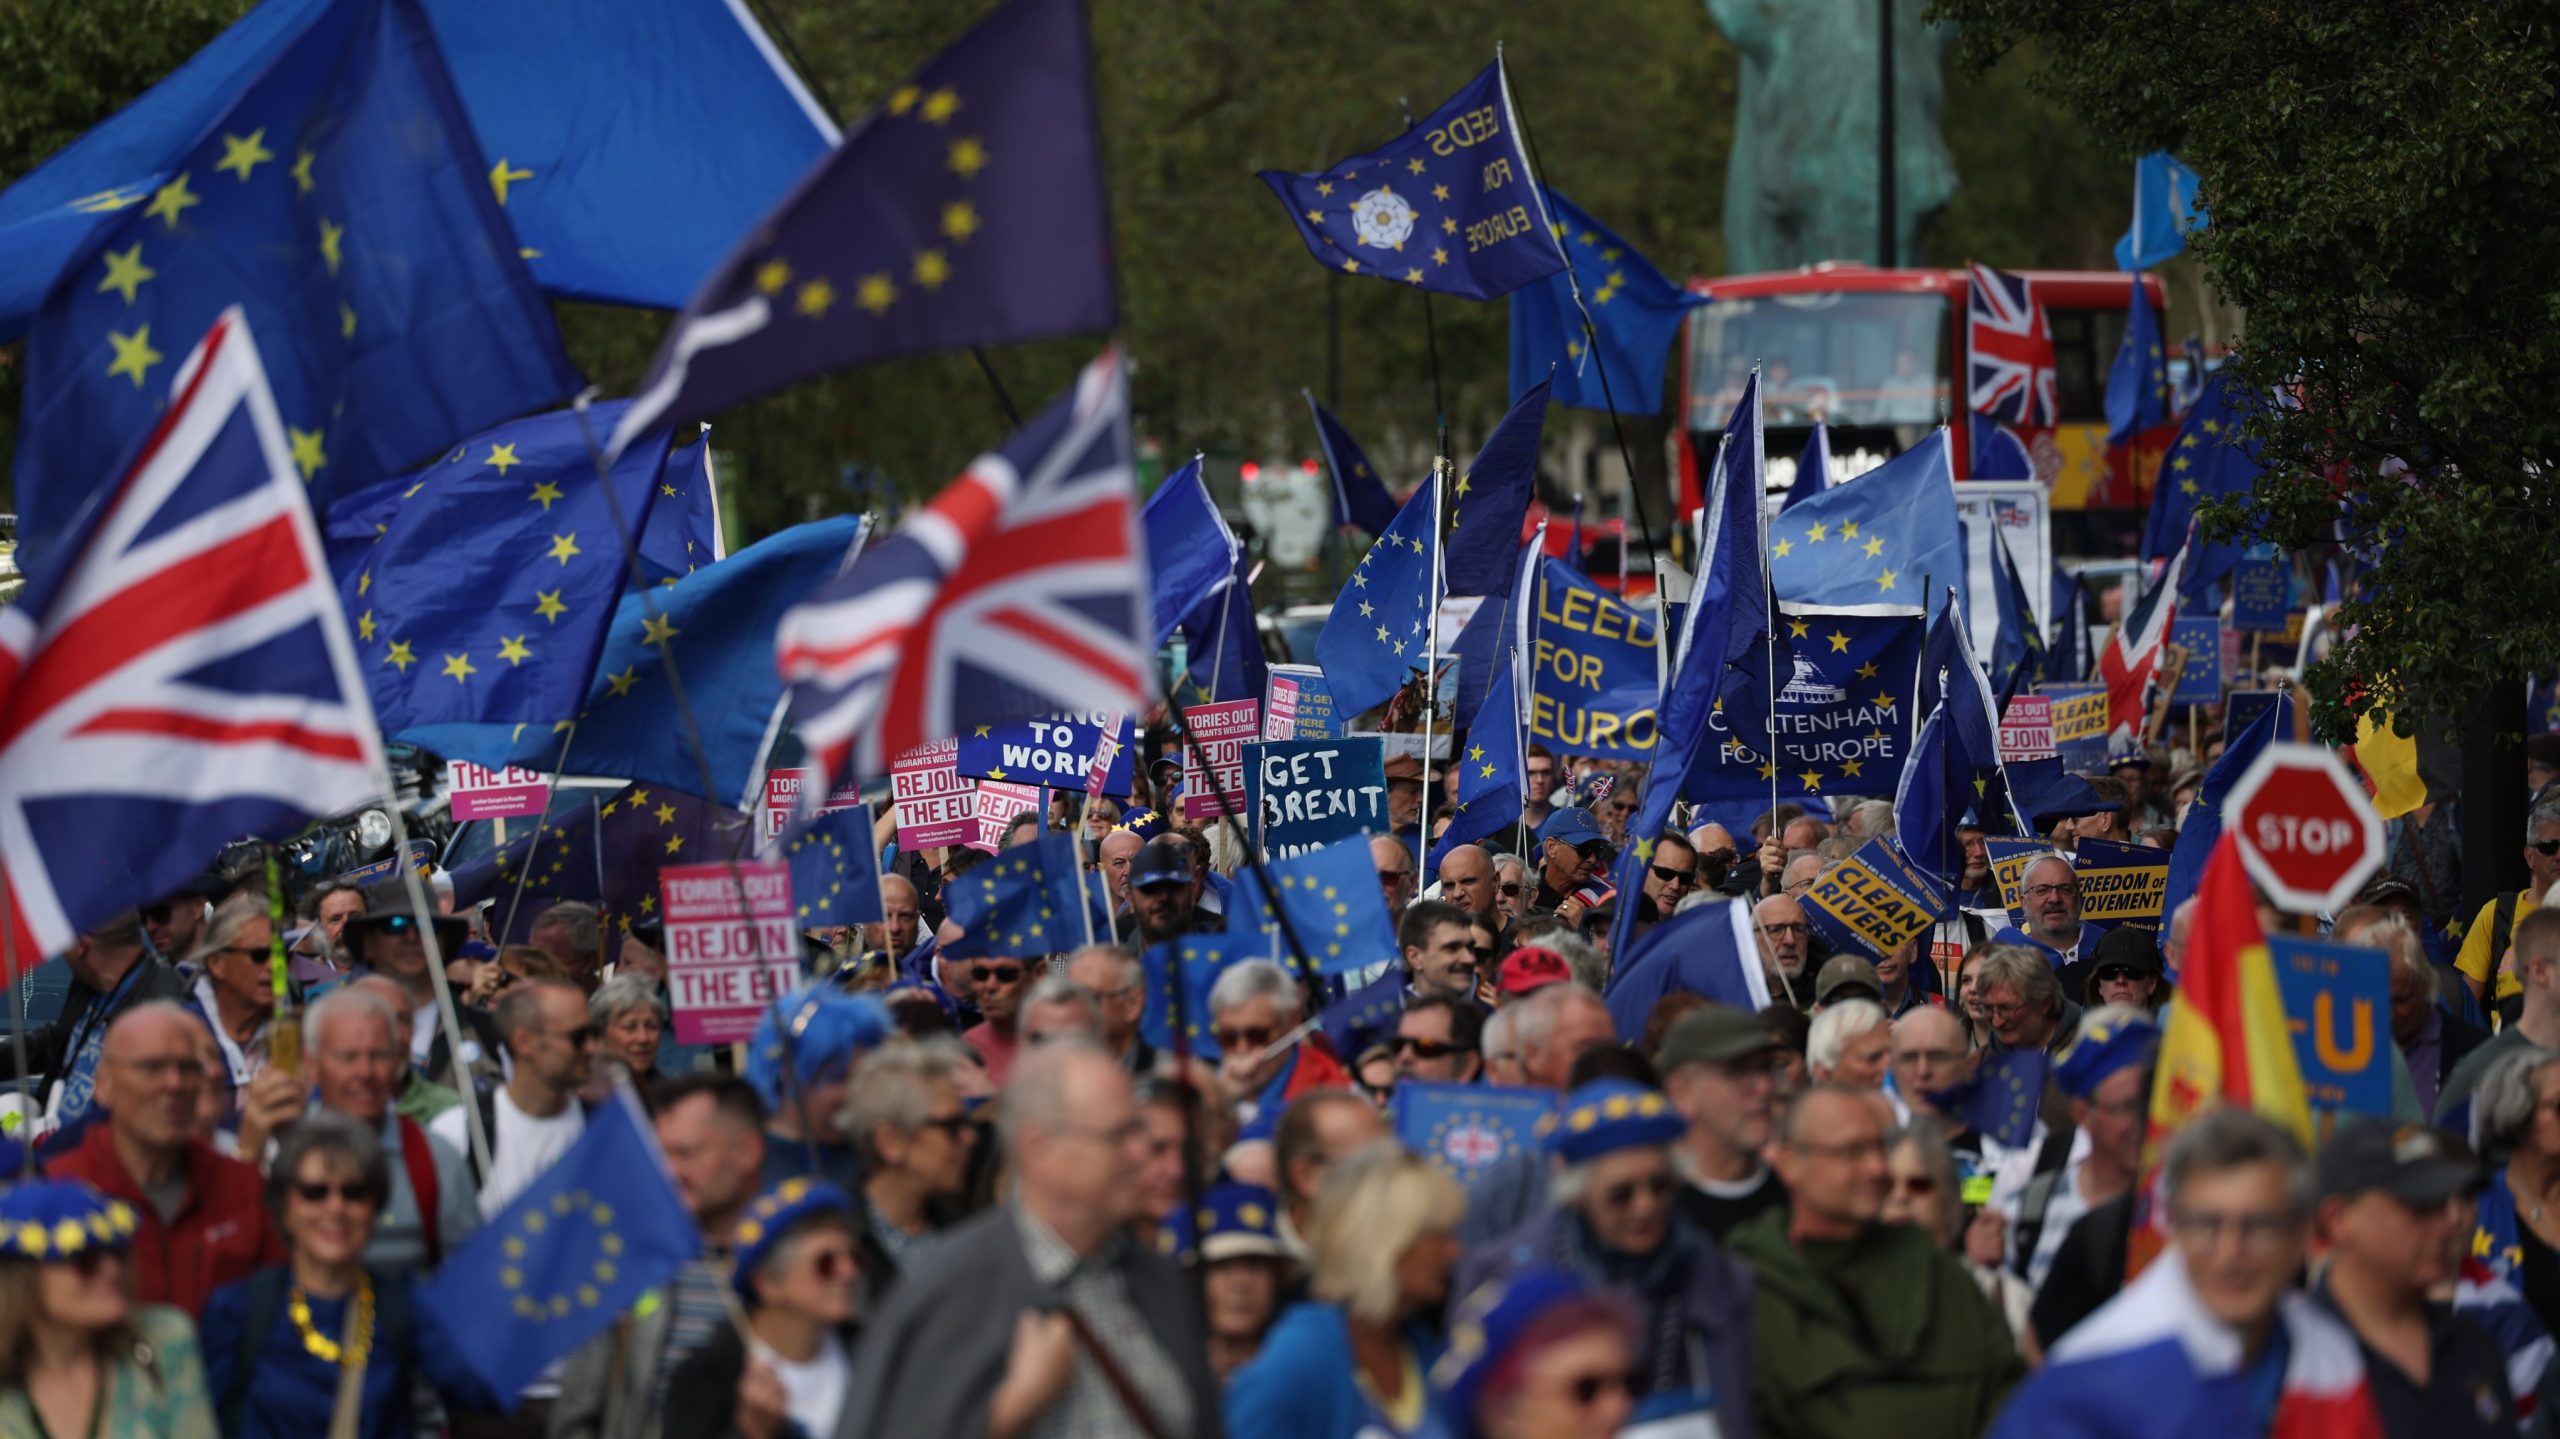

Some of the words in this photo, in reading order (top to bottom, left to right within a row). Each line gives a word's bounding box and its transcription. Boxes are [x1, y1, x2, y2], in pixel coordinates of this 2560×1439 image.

[1540, 579, 1659, 648] LEED
[1536, 639, 1604, 692] FOR
[1186, 711, 1230, 730] TORIES
[1232, 707, 1256, 724] OUT
[1531, 693, 1658, 749] EURO
[1708, 704, 1898, 735] CLTENHAM
[2024, 702, 2047, 716] OUT
[2052, 698, 2106, 721] LEAN
[1029, 721, 1073, 748] TO
[1189, 726, 1223, 739] IGRANTS
[1297, 717, 1326, 729] HERE
[2055, 714, 2106, 736] IVERS
[941, 736, 958, 752] OU
[2002, 729, 2050, 748] EJOIN
[932, 752, 957, 764] WELCO
[1002, 744, 1097, 777] WORK
[1188, 739, 1250, 768] REJOI
[1720, 743, 1765, 765] FO
[452, 762, 500, 789] THE
[1265, 749, 1339, 788] GET
[896, 768, 970, 798] REJOIN
[1016, 787, 1040, 798] WELCO
[899, 799, 941, 826] THE
[946, 795, 973, 820] EU
[978, 794, 1040, 821] REJO
[1264, 786, 1384, 828] BREXIT
[2257, 813, 2354, 855] STOP
[2152, 877, 2166, 889] OF
[1836, 867, 1927, 933] CLEAN
[2082, 891, 2163, 912] OVEMENT
[1814, 882, 1907, 947] RIVERS
[678, 970, 741, 1004] THE
